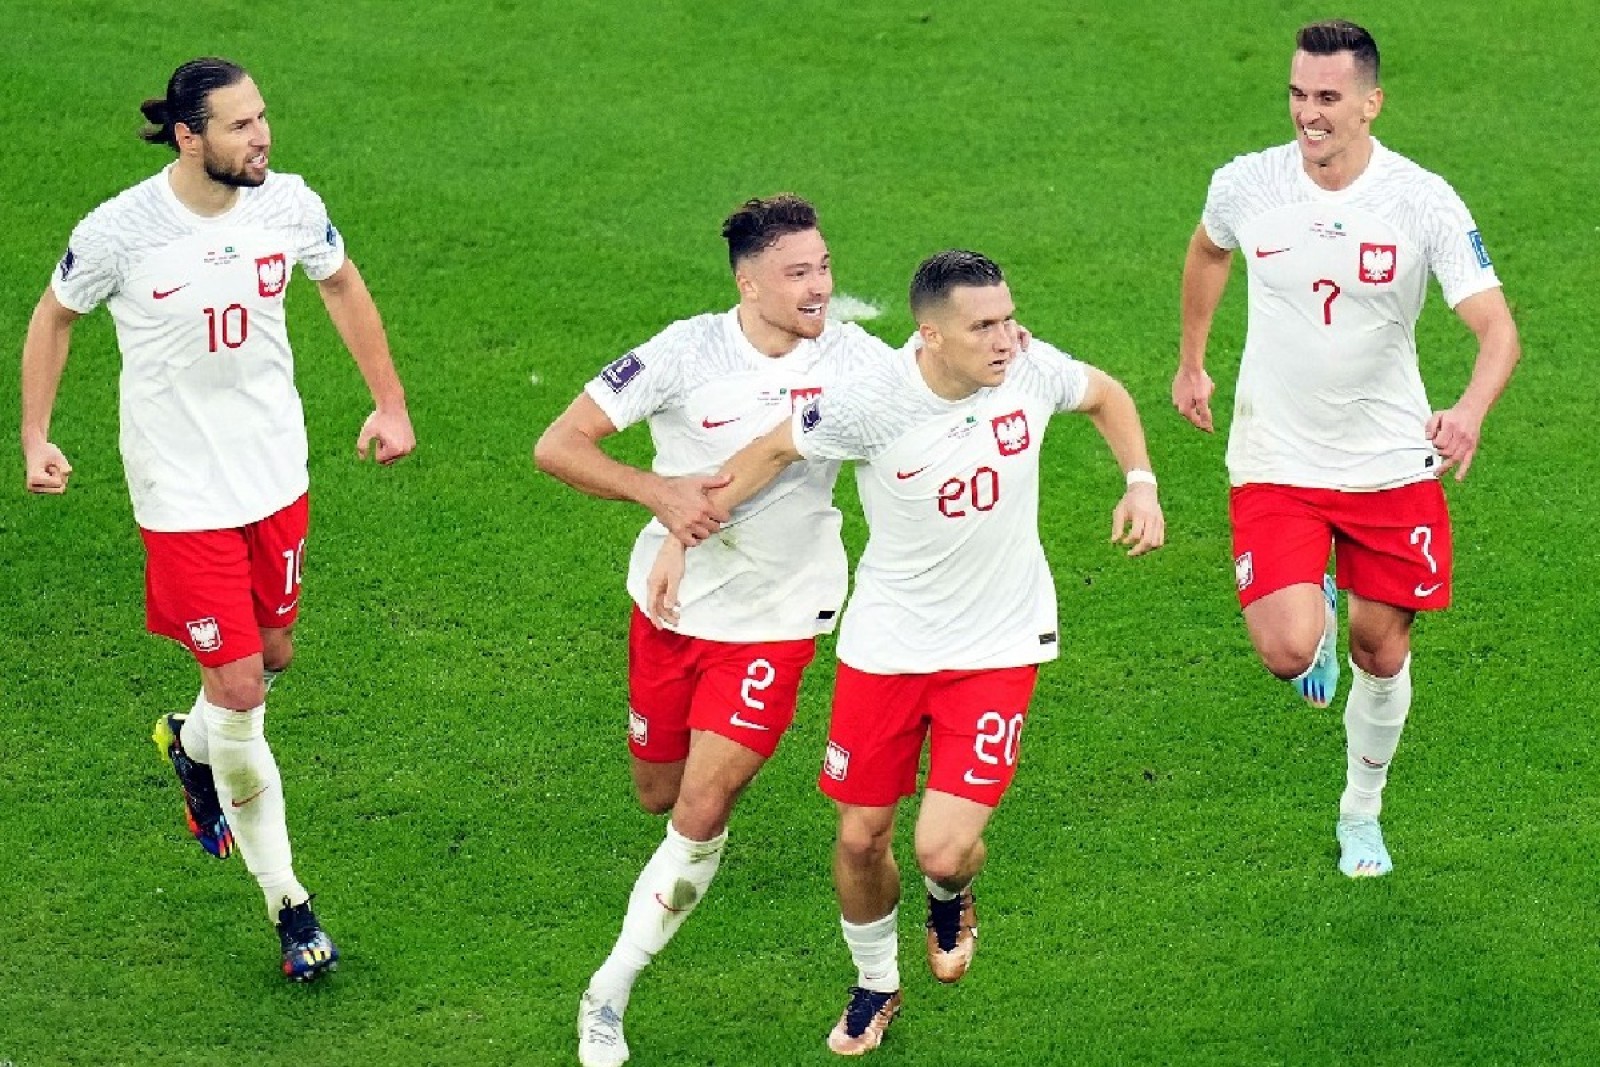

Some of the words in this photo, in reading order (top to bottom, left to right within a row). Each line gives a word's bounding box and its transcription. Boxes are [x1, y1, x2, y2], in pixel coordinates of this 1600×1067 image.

[1312, 278, 1341, 325] 7
[203, 303, 248, 353] 10
[938, 466, 999, 518] 20
[1410, 526, 1437, 574] 7
[741, 658, 776, 710] 2
[974, 711, 1023, 766] 20
